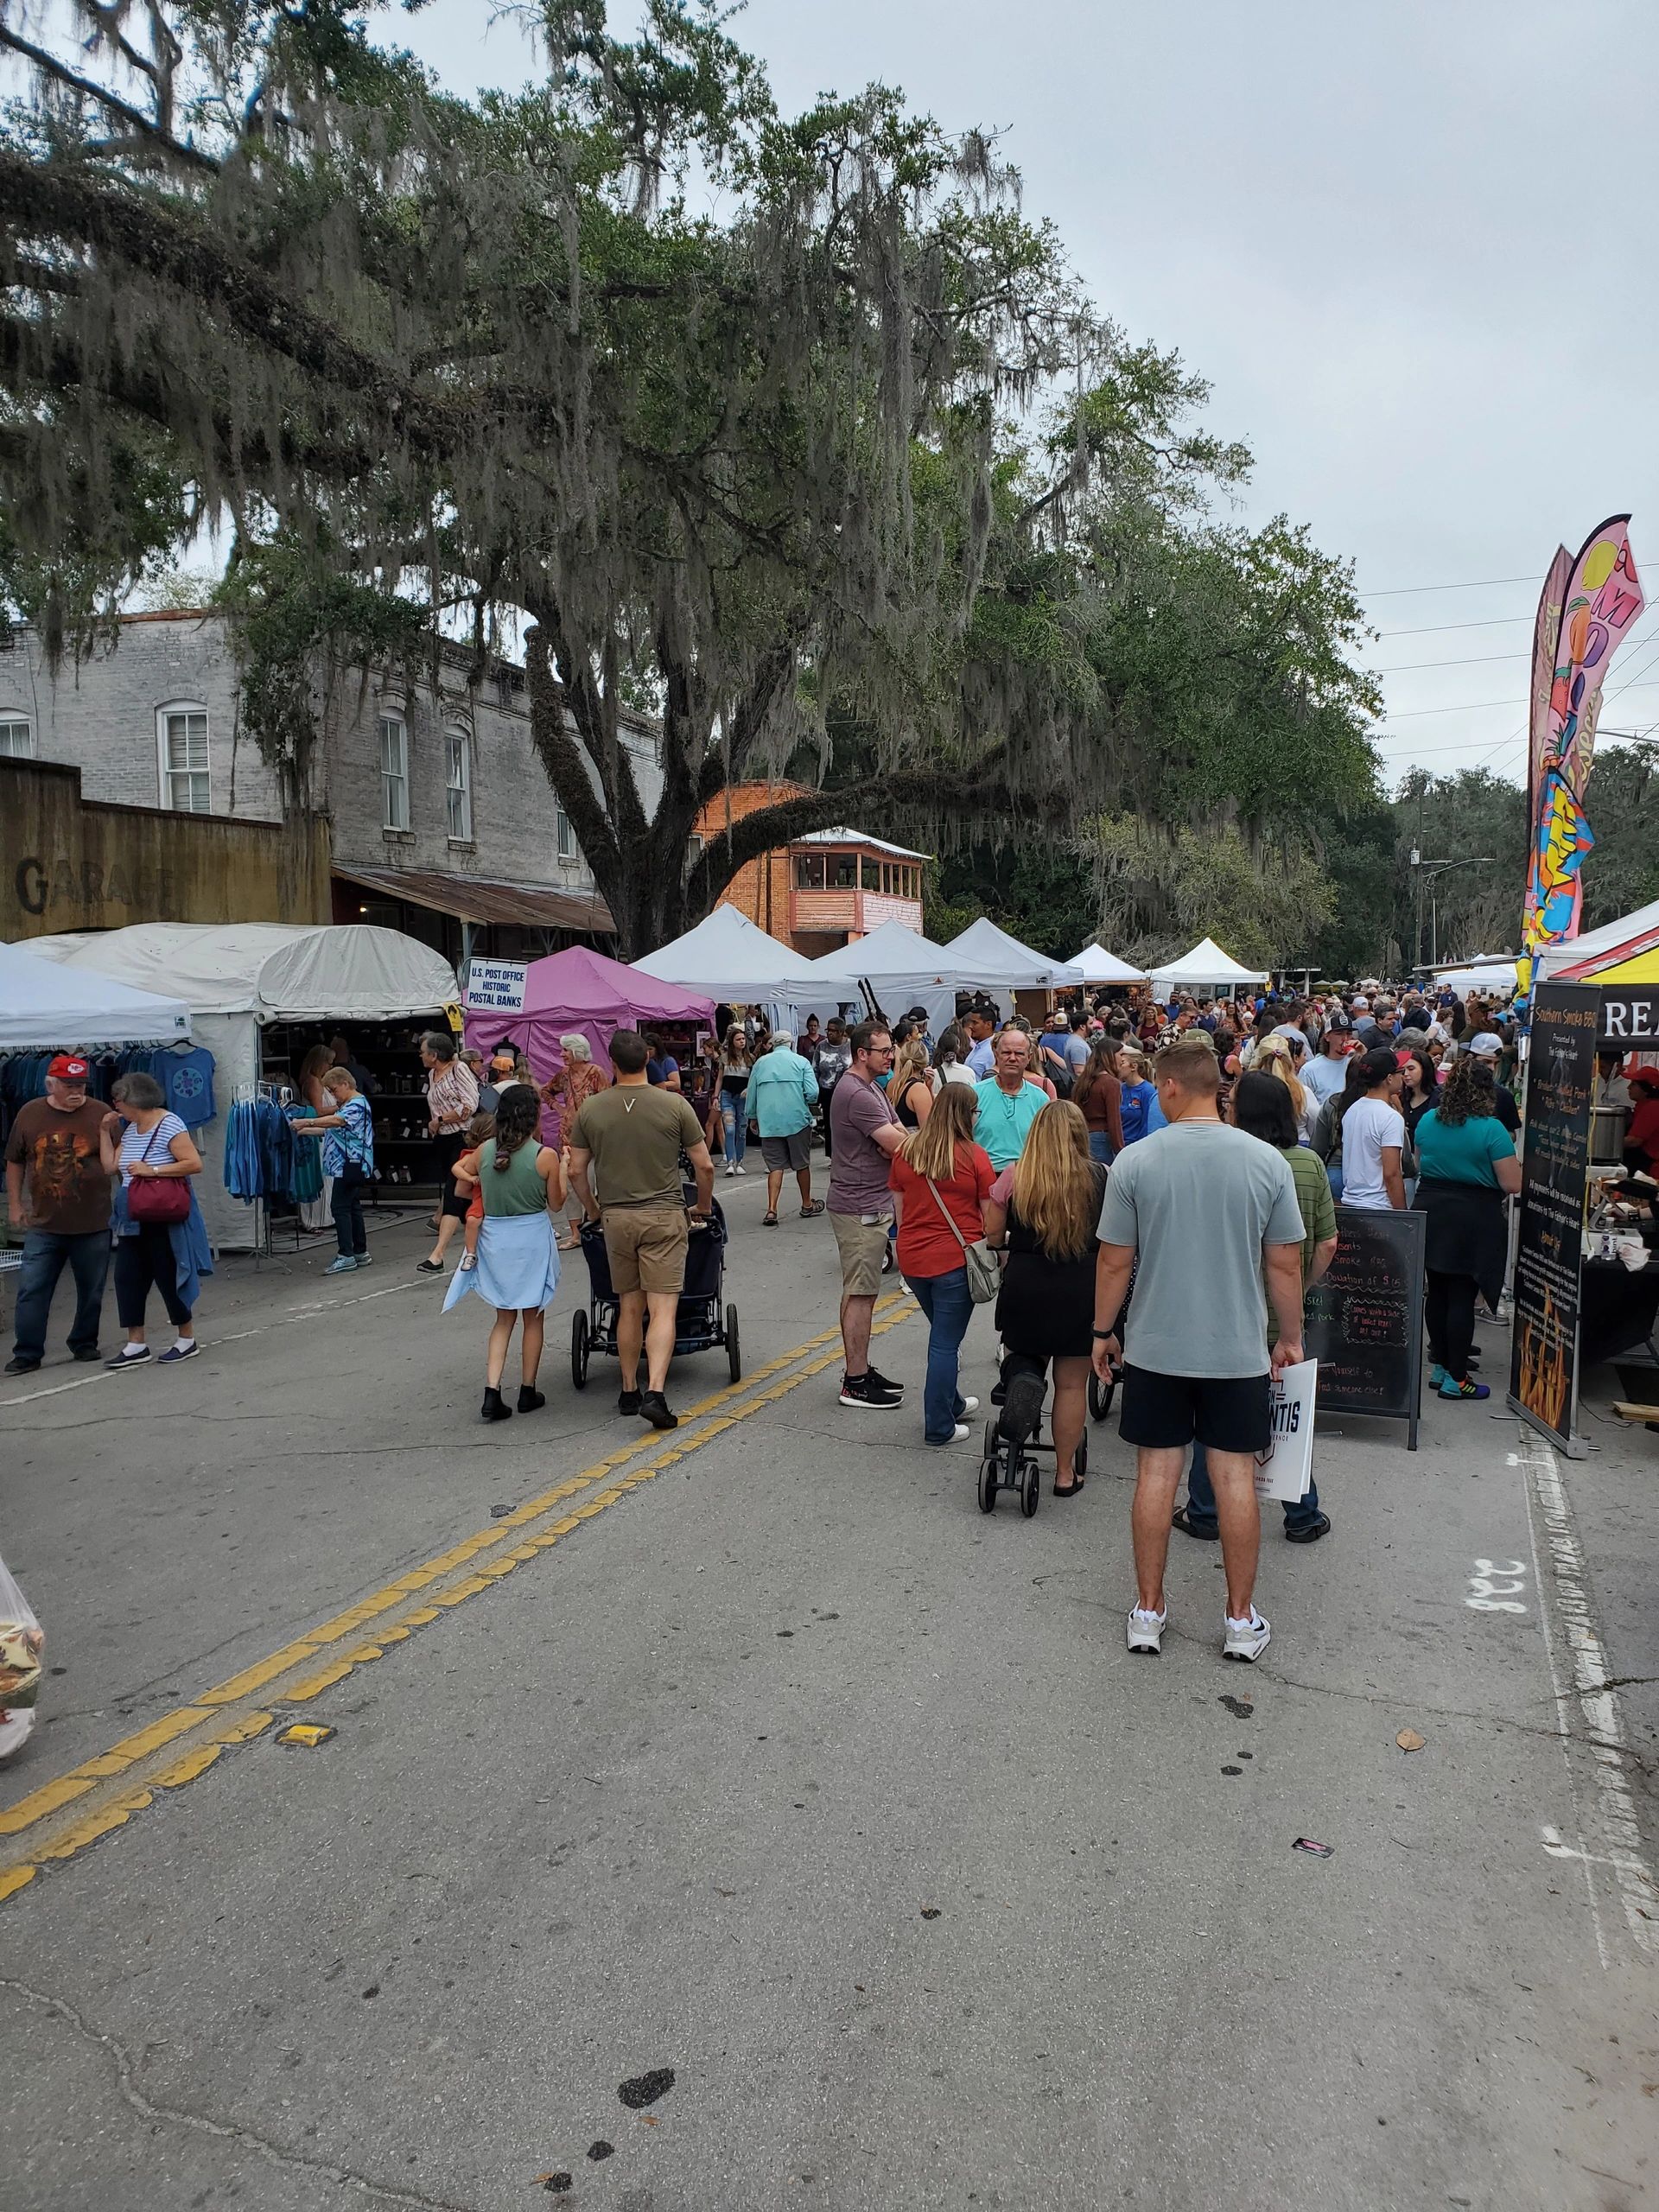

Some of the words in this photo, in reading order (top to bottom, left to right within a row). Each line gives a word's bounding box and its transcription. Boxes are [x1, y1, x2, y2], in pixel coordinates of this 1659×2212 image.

[472, 967, 484, 978] U.S.
[485, 969, 502, 980] POST
[502, 970, 525, 982] OFFICE
[482, 981, 512, 993] HISTORIC
[469, 992, 495, 1005] POSTAL
[496, 995, 522, 1007] BANKS
[1535, 1006, 1562, 1024] Southern
[1562, 1008, 1583, 1027] Smoke
[1605, 1001, 1659, 1037] RE
[1338, 1241, 1362, 1251] esents
[1305, 1295, 1323, 1306] sket
[1270, 1401, 1300, 1433] NTIS
